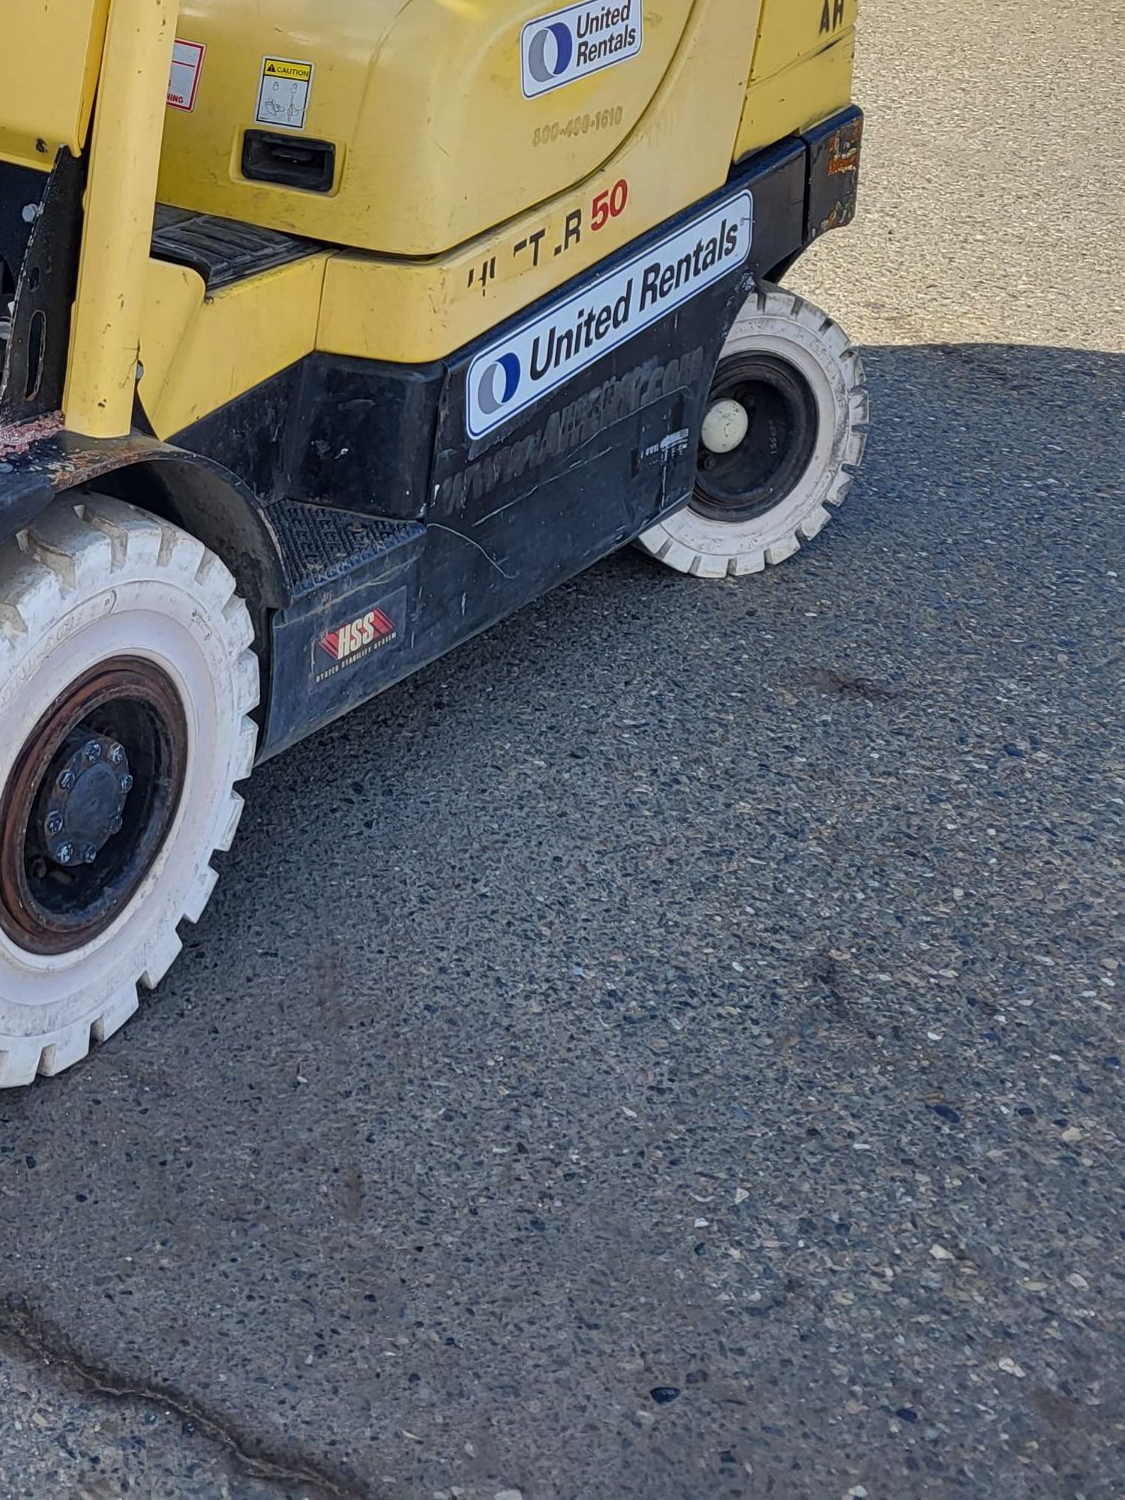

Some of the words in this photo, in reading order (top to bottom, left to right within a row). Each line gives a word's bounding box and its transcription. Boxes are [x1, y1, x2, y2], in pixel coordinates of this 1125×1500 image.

[576, 24, 636, 67] Rentals
[276, 66, 309, 77] CAUTION
[590, 178, 629, 232] 50
[529, 277, 634, 382] United
[639, 217, 739, 314] Rentals
[337, 611, 375, 660] HSS
